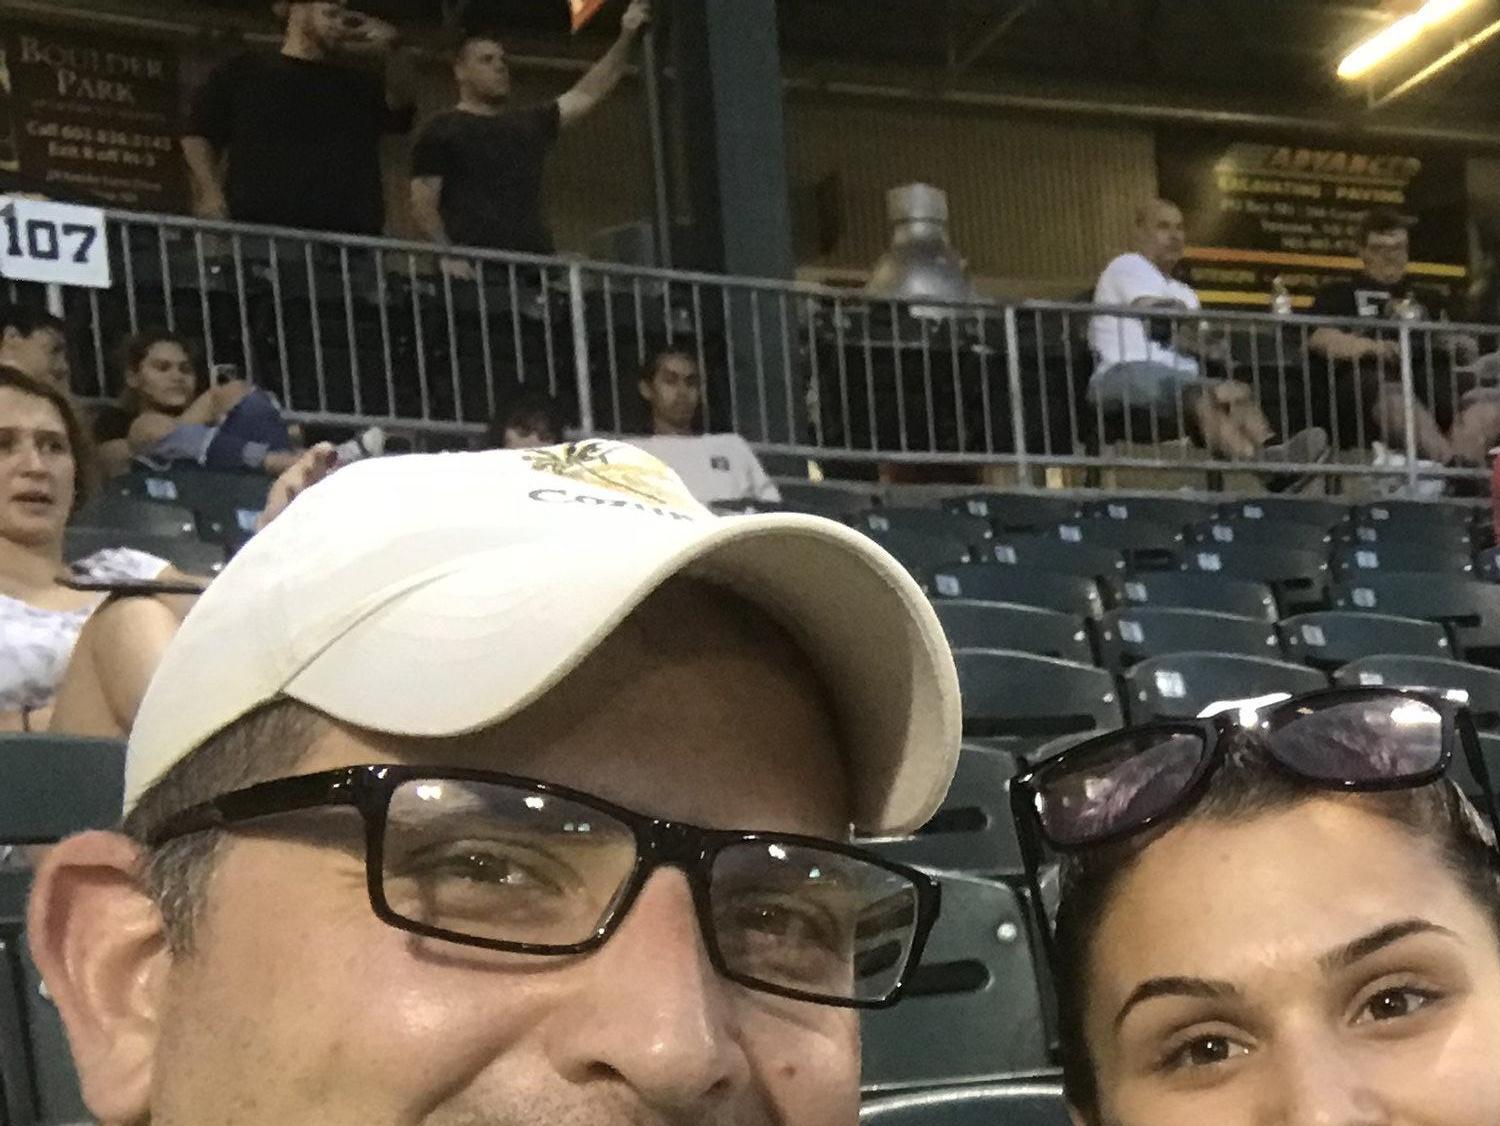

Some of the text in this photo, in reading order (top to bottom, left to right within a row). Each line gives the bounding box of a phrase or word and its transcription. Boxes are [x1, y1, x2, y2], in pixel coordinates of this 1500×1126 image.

[20, 35, 165, 82] BOULDER
[56, 66, 136, 104] PARK
[0, 203, 97, 264] 107
